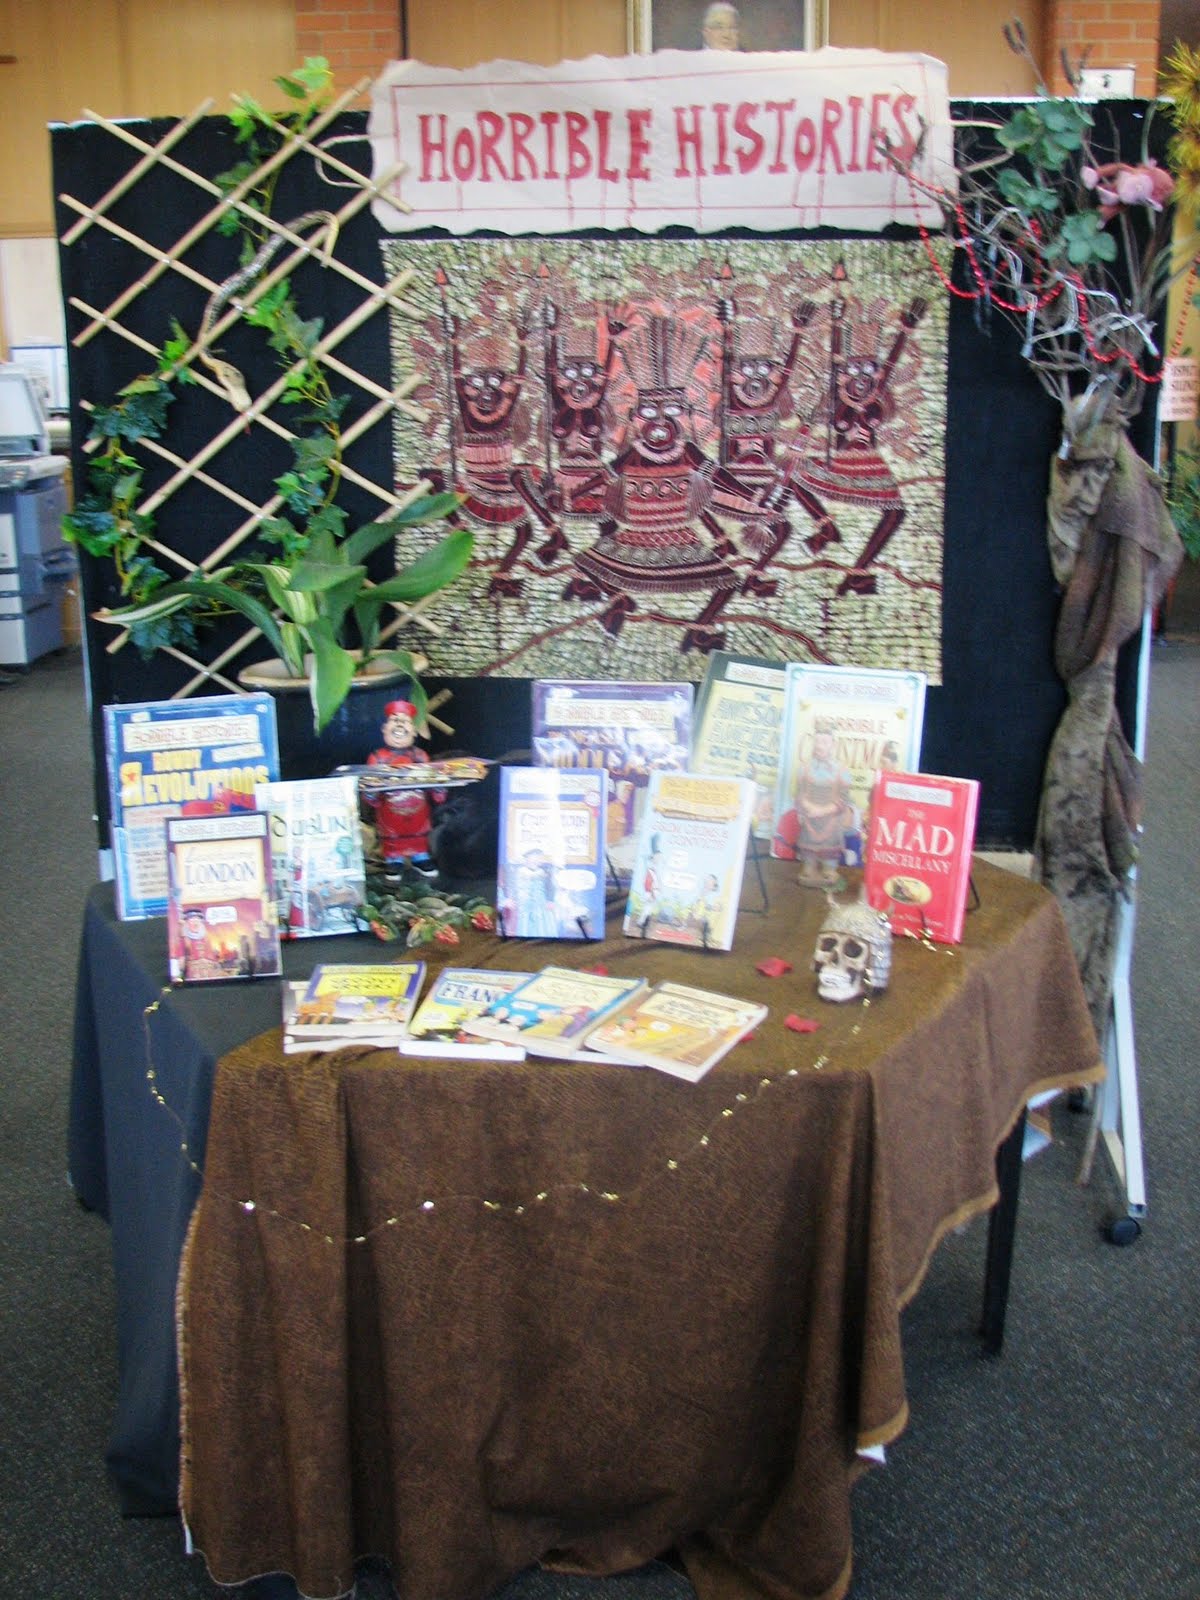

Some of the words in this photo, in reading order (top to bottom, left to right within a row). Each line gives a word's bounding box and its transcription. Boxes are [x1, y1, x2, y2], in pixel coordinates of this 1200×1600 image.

[417, 108, 652, 183] HORRIBLE
[673, 93, 920, 180] HISTORIES
[875, 816, 955, 857] MAD
[184, 861, 257, 885] LONDON
[872, 849, 952, 874] MISCELLANY
